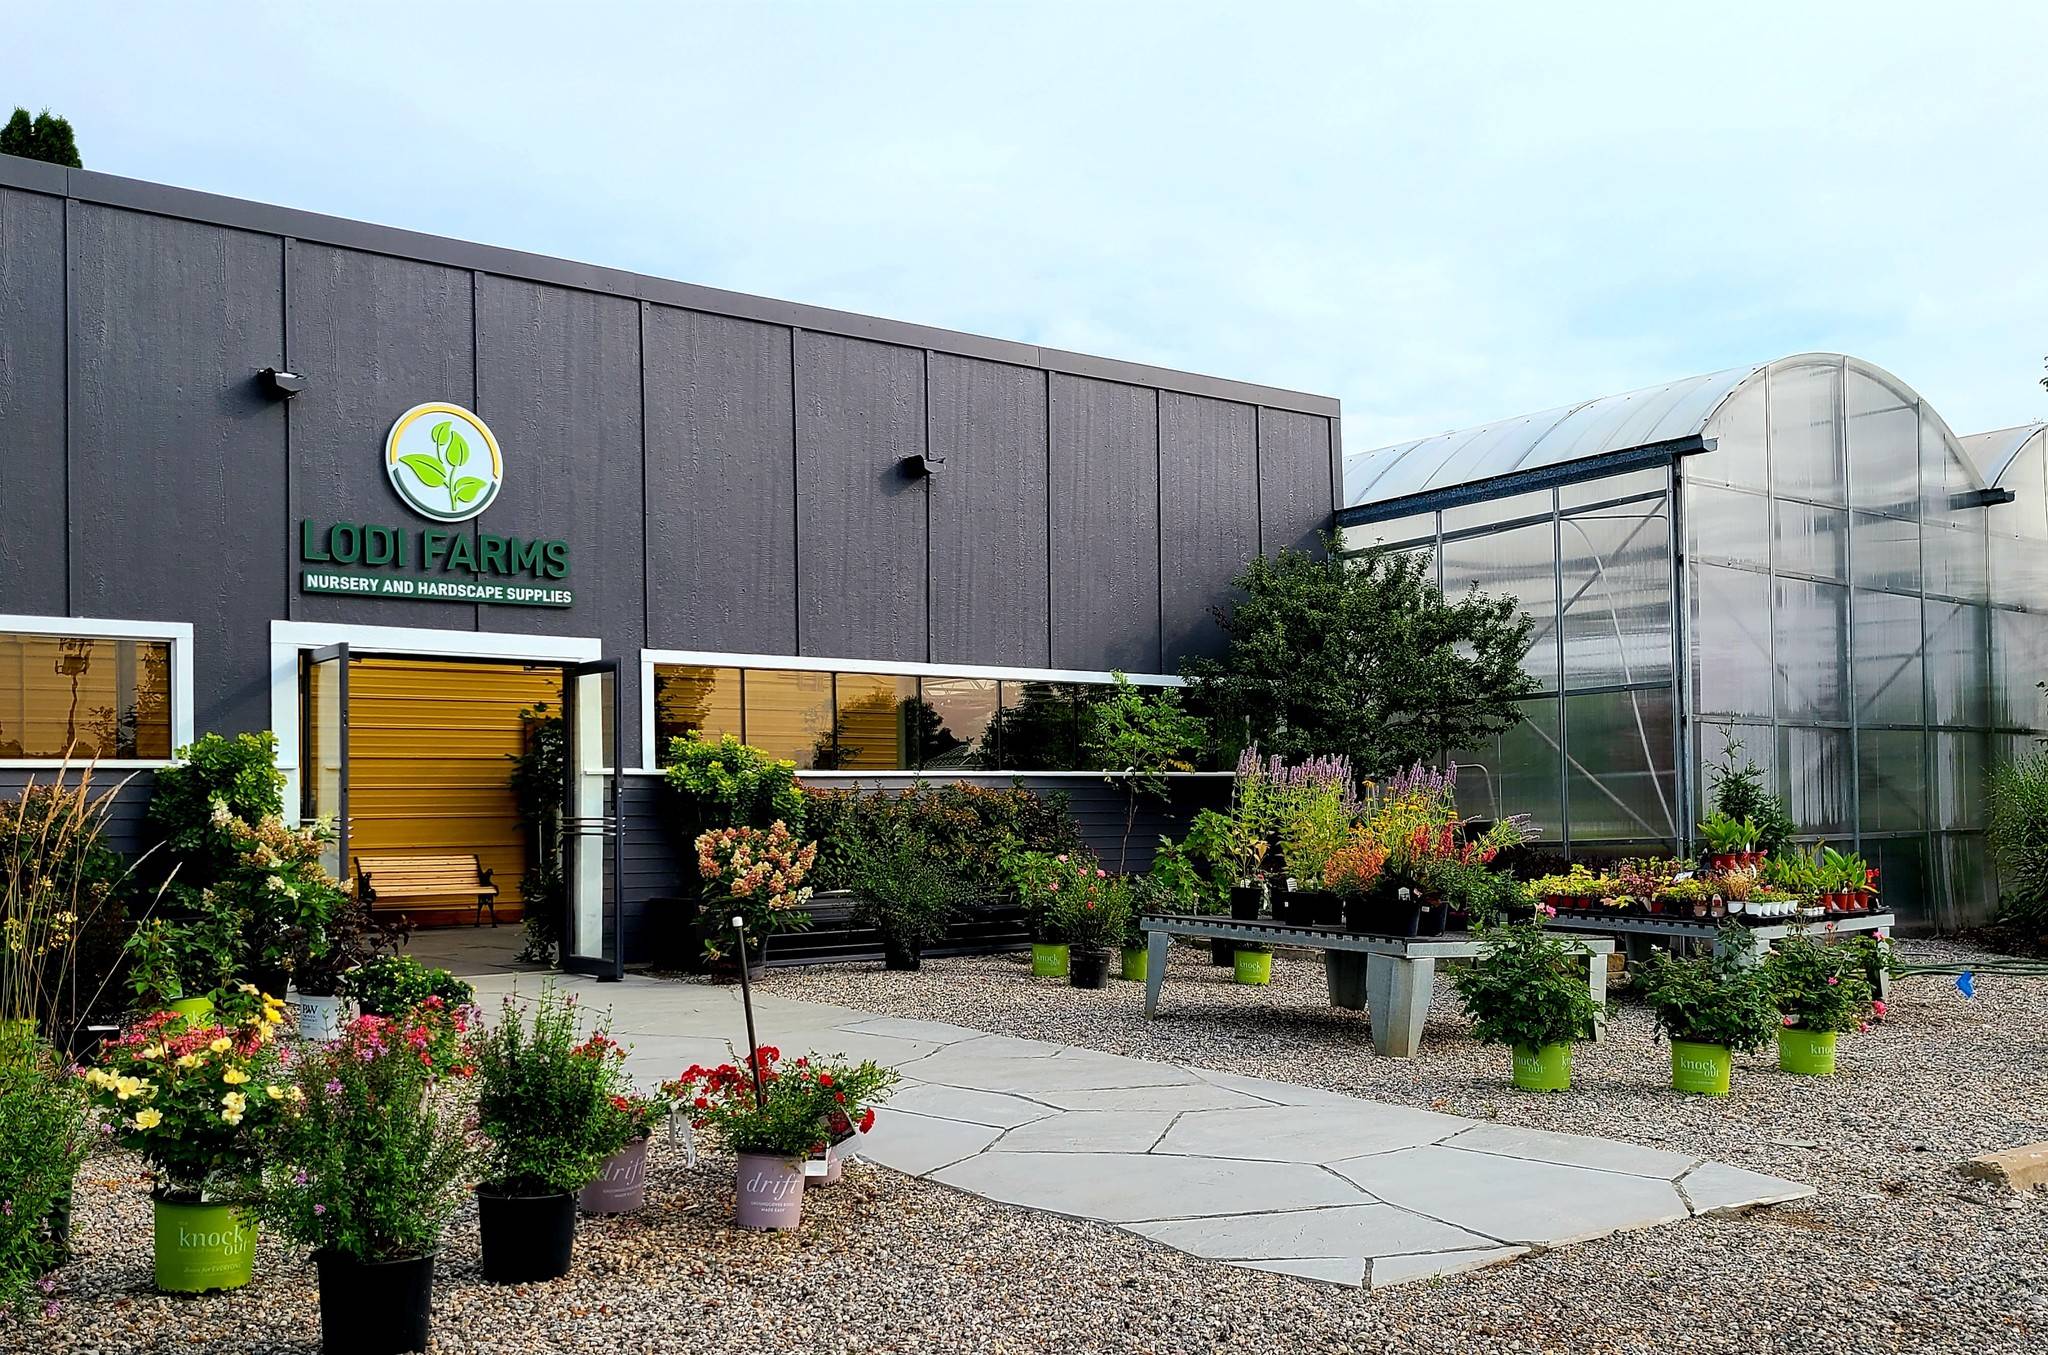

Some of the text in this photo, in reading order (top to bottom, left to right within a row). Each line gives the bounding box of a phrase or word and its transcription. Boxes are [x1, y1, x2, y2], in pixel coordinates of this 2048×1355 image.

[303, 519, 571, 579] LODI FARMS
[306, 574, 572, 603] NURSERY AND HARDSCAPE SUPPLIES
[1239, 961, 1261, 970] knock
[1680, 1056, 1717, 1071] knock
[1703, 1067, 1719, 1078] out
[746, 1172, 800, 1201] drift
[179, 1224, 244, 1248] knock
[224, 1239, 247, 1257] out
